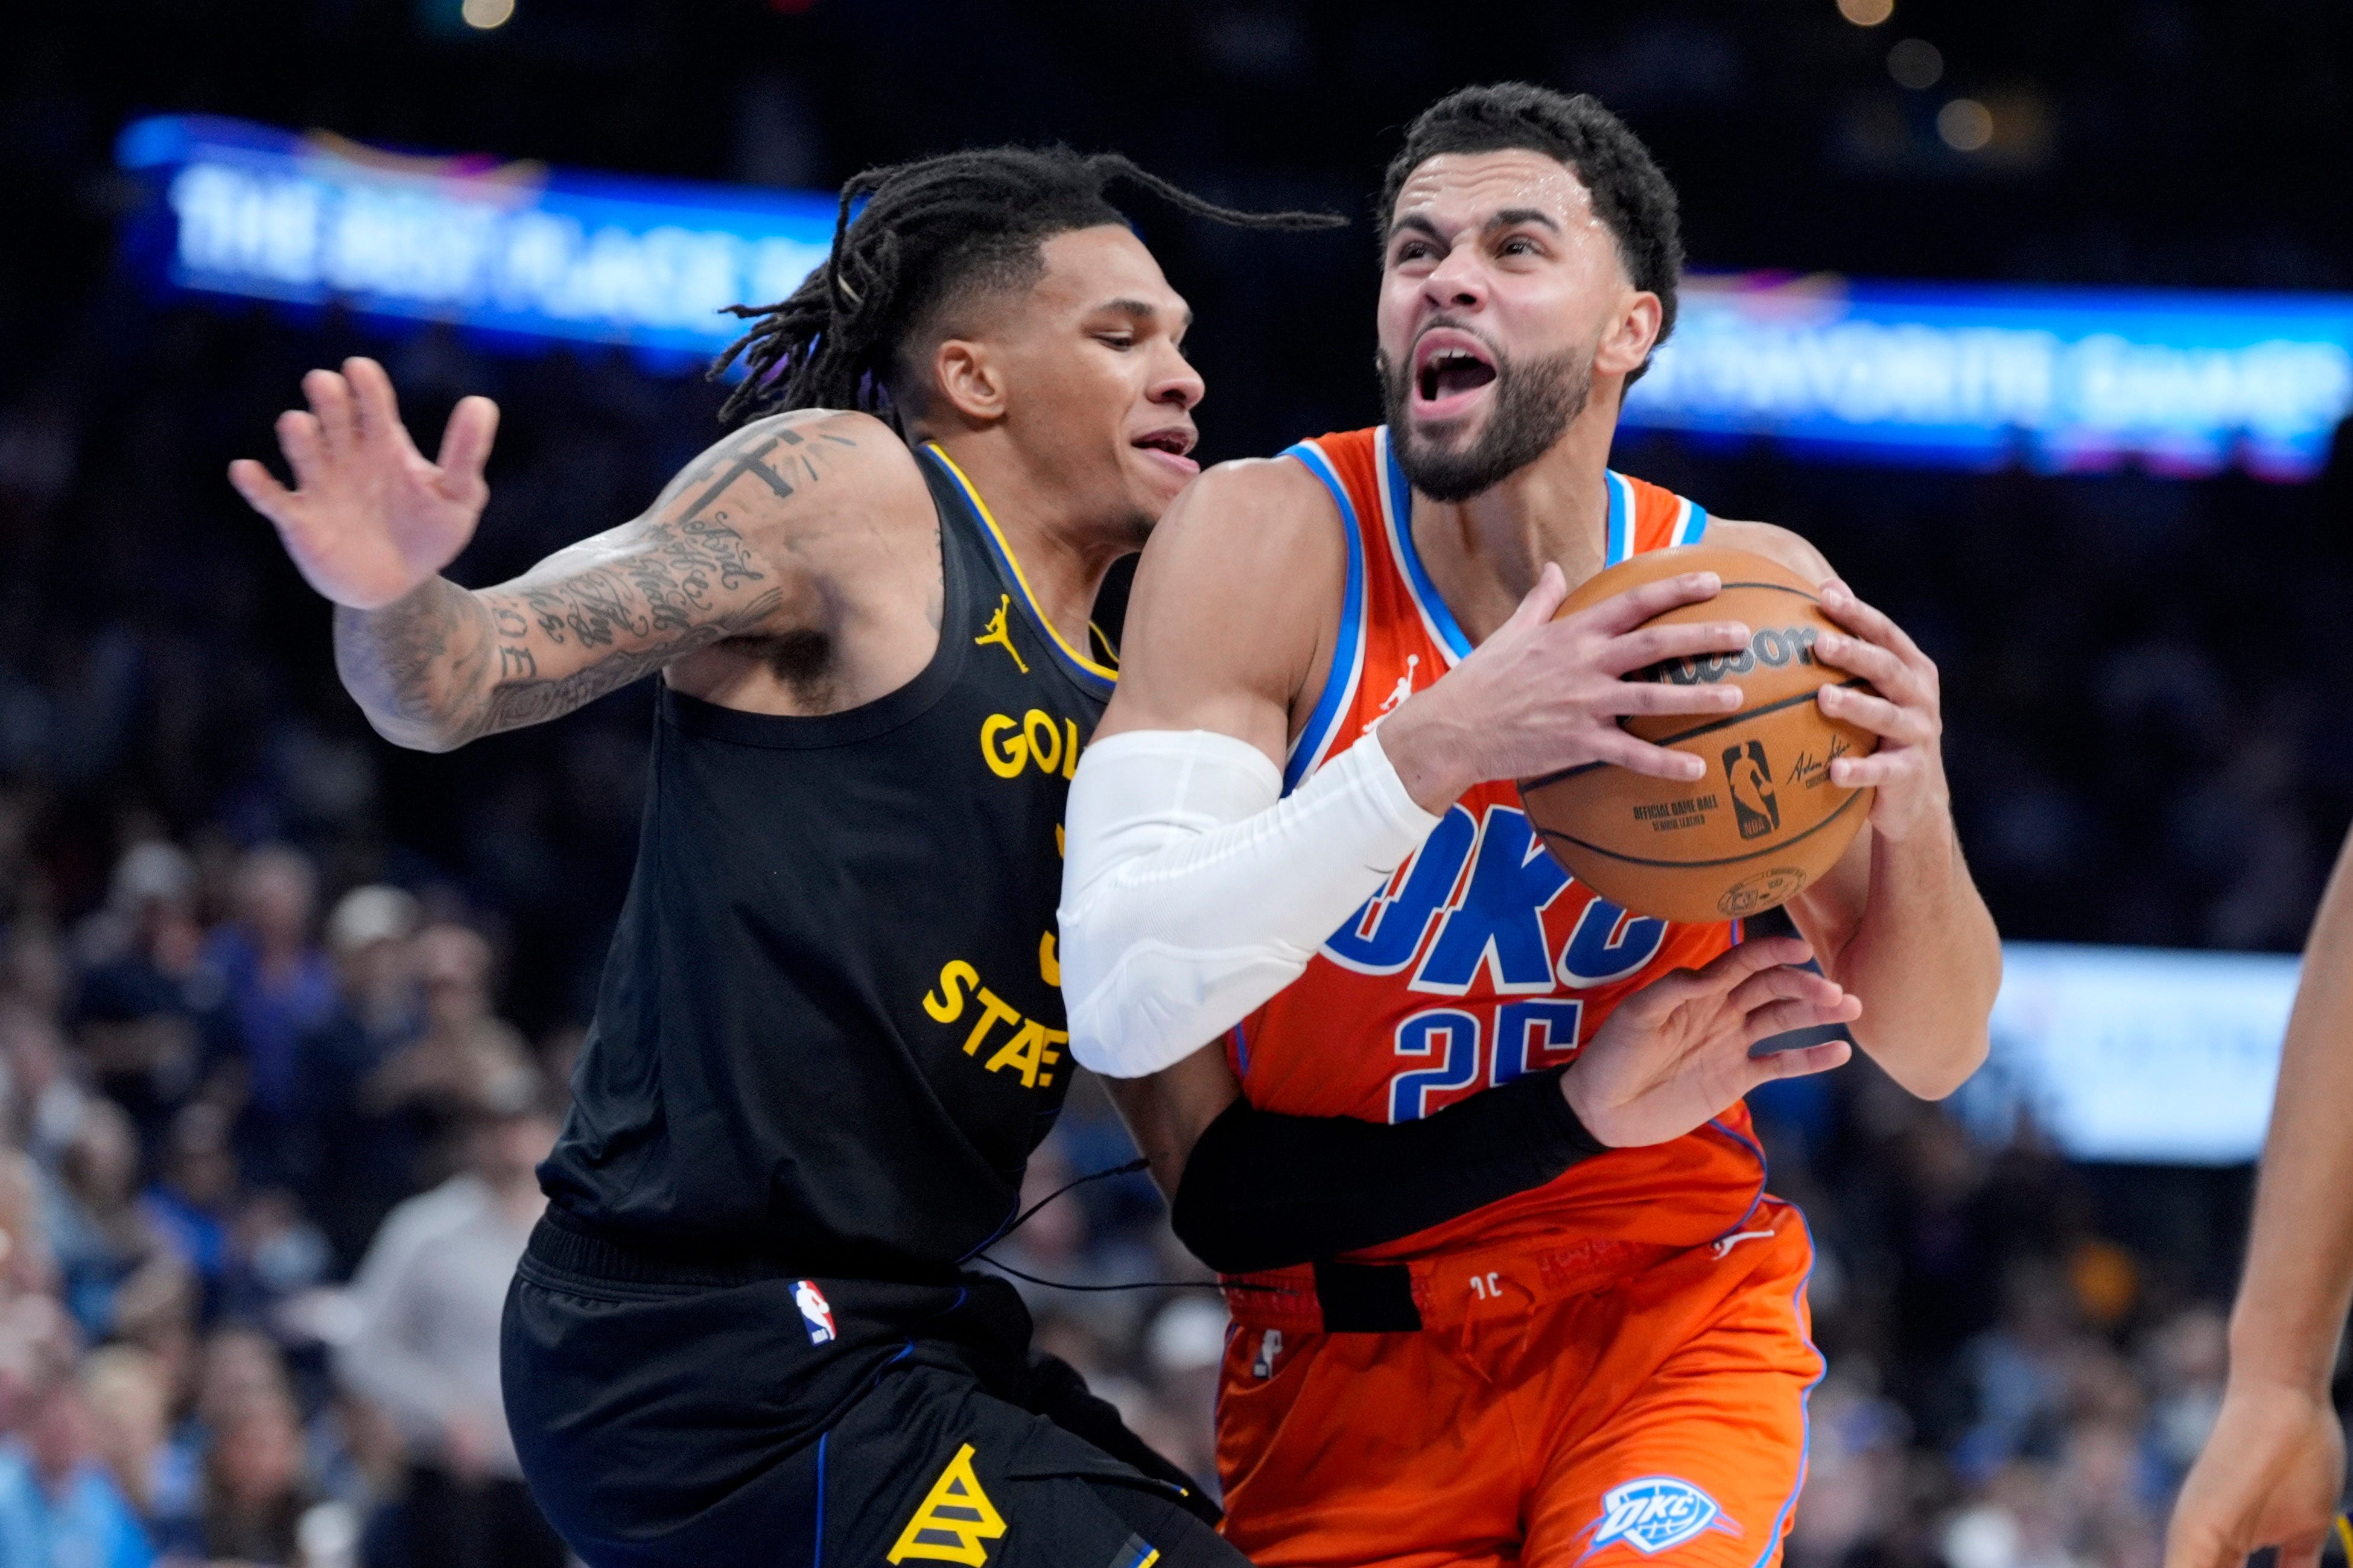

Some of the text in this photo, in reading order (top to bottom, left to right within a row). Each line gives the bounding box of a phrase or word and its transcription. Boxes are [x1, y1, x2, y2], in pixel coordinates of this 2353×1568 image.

[980, 708, 1078, 780] GOL
[1671, 798, 1695, 816] GAME
[1696, 793, 1719, 811] BALL
